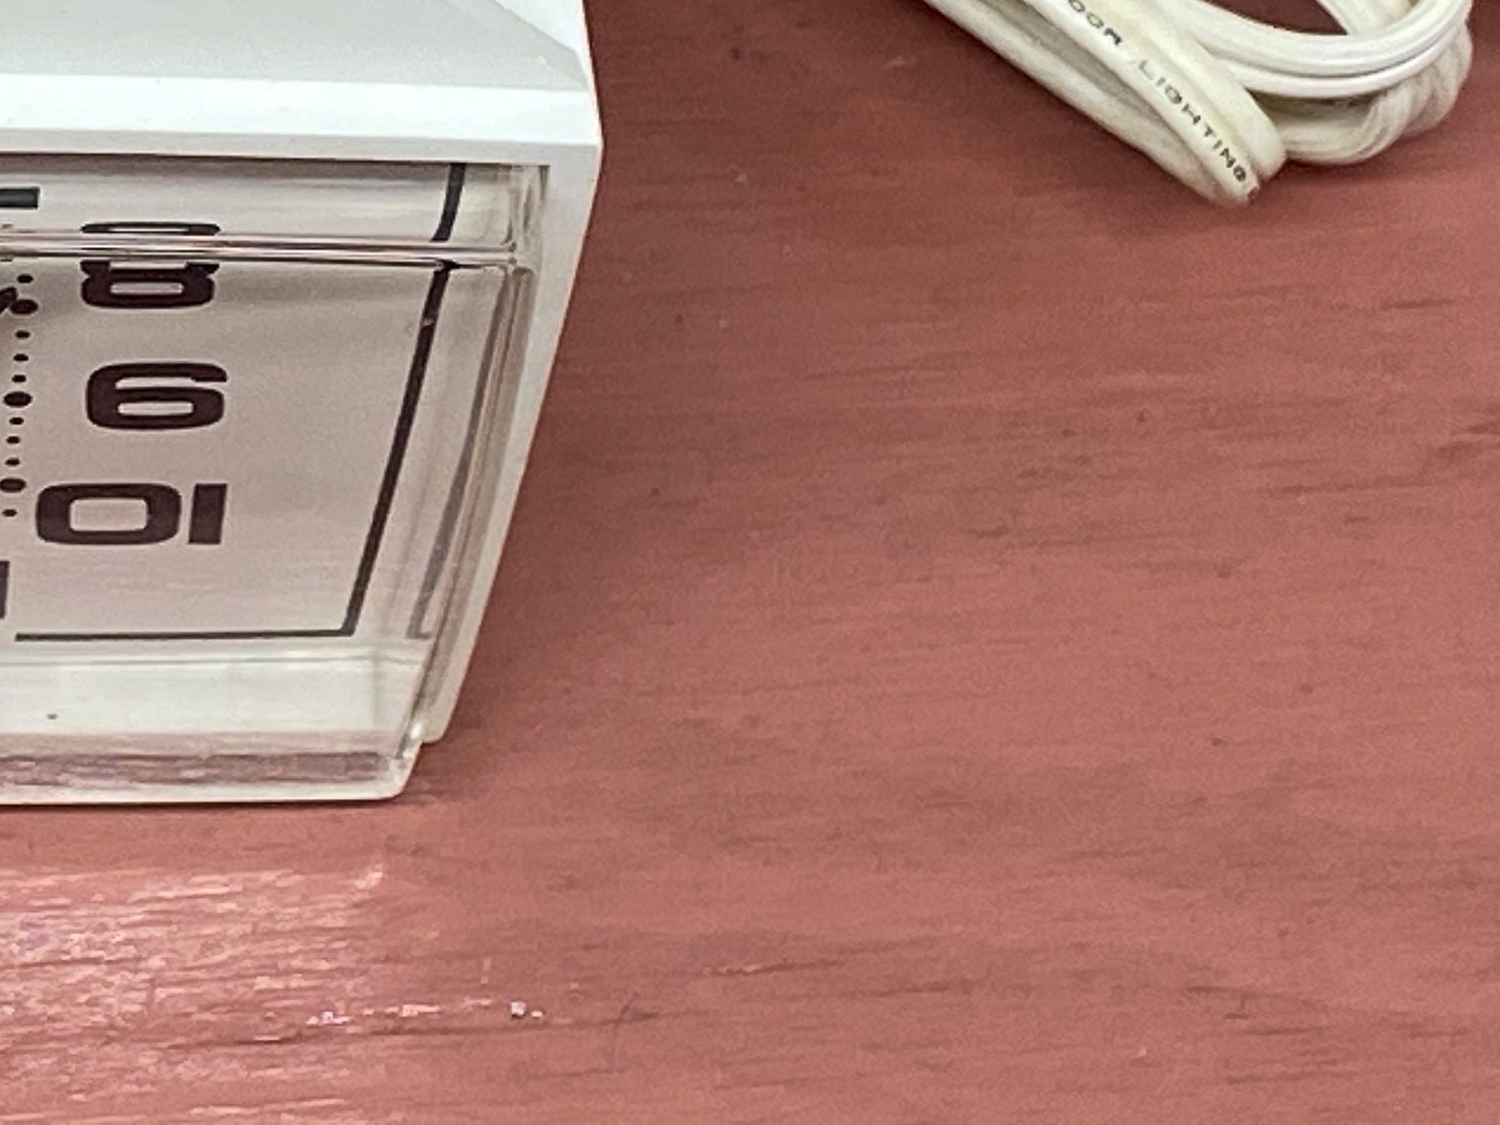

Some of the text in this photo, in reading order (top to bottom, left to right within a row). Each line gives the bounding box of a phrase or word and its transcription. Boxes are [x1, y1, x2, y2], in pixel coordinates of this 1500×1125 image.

[1138, 60, 1247, 182] LIGHTING
[80, 221, 220, 308] 8
[86, 363, 228, 429] 9
[35, 483, 227, 544] 10
